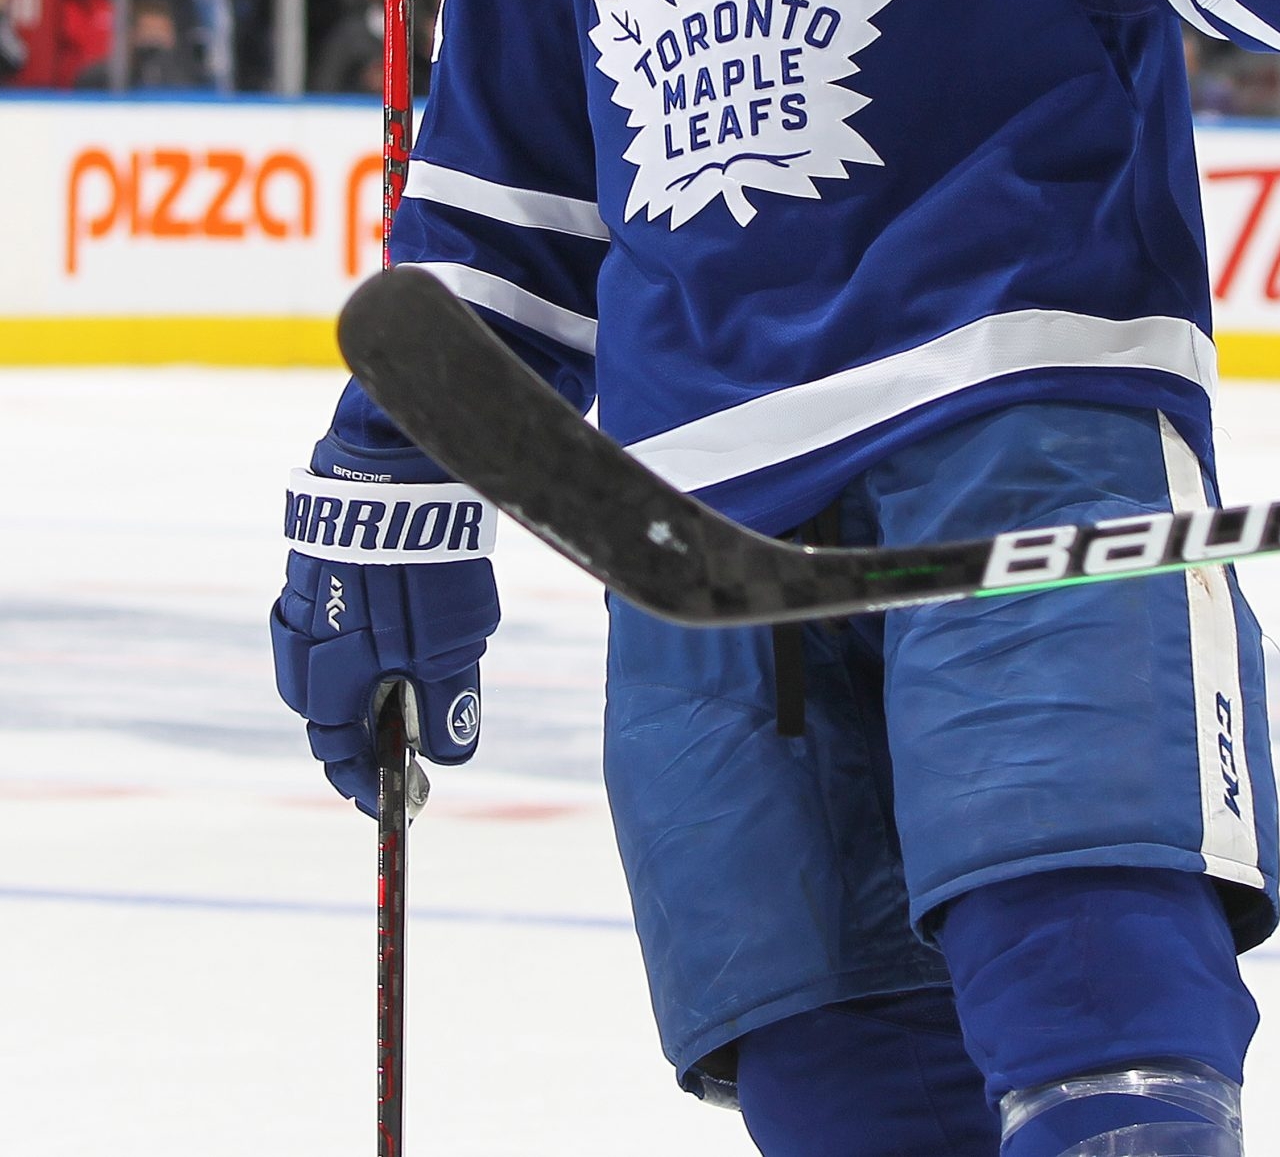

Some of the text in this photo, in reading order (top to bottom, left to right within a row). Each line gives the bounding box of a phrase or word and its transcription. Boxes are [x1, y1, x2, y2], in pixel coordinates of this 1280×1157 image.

[662, 47, 805, 116] MAPLE
[664, 93, 808, 160] LEAFS
[63, 147, 314, 276] pizza
[333, 464, 392, 483] BRODIE
[1215, 691, 1241, 821] CCM
